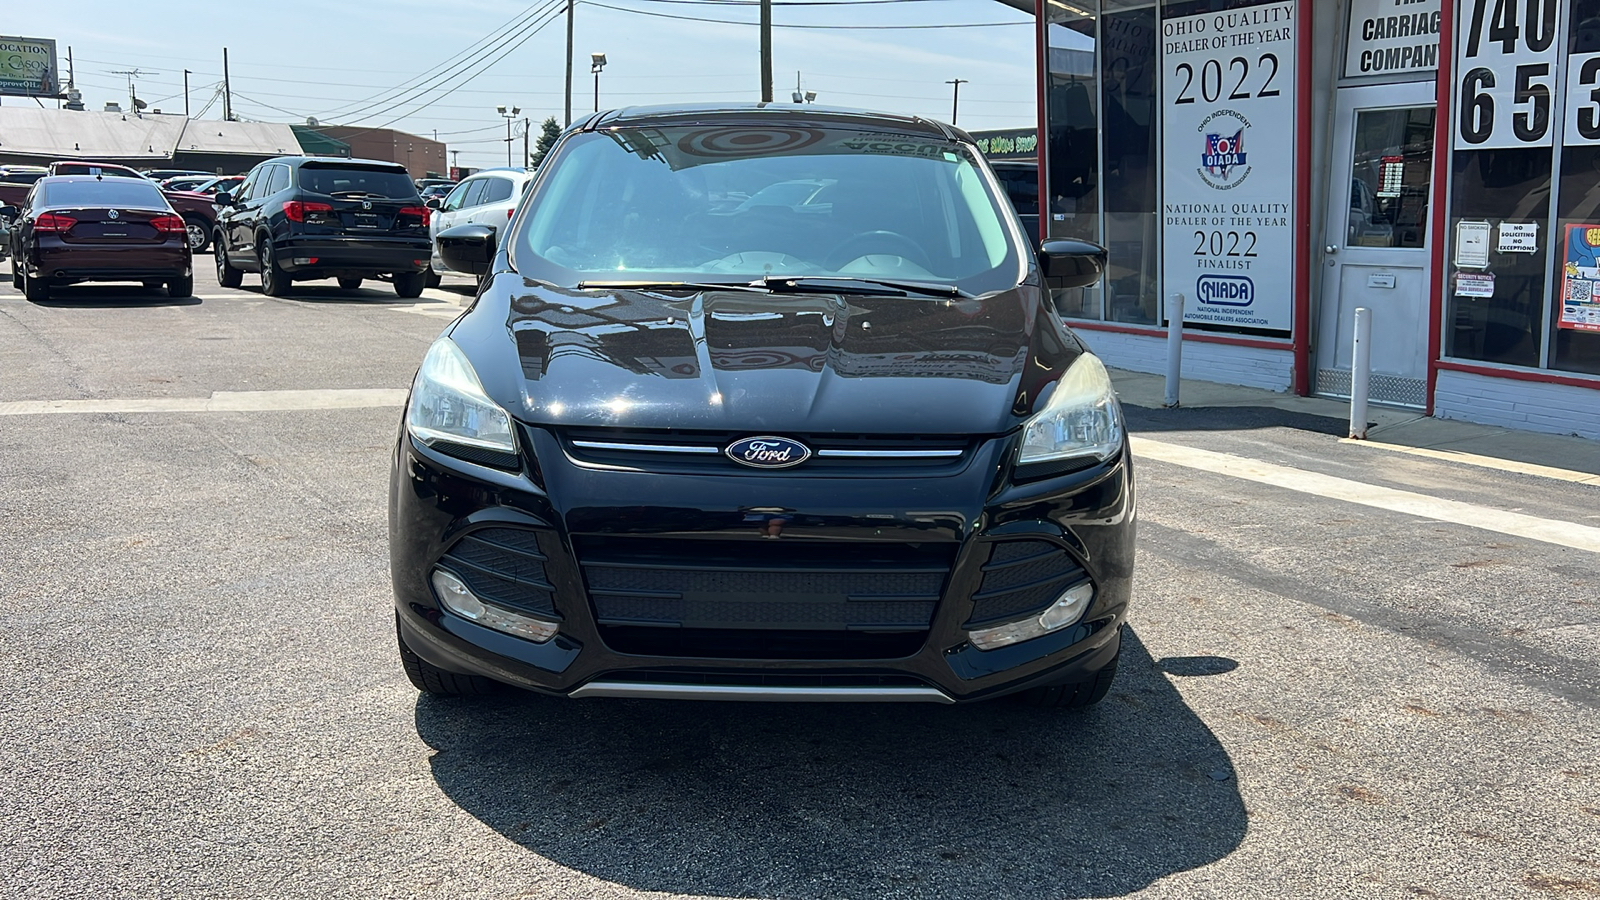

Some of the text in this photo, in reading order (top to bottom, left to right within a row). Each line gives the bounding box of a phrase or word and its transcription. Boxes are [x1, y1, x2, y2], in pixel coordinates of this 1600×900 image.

[1164, 5, 1293, 37] OHIO QUALITY
[1165, 38, 1209, 54] DEALER
[1211, 36, 1227, 49] OF
[1230, 32, 1254, 46] THE
[1257, 27, 1290, 43] YEAR
[8, 54, 48, 70] CASON
[1360, 43, 1440, 72] COMPAN
[1174, 52, 1280, 105] 2022
[1197, 109, 1252, 133] OHIO INDEPENDENT
[1015, 134, 1038, 153] SHOP
[1207, 154, 1239, 166] OIADA
[1165, 203, 1289, 215] NATIONAL QUALITY
[1166, 217, 1287, 227] DEALER OF THE YEAR
[1193, 230, 1258, 258] 2022
[1197, 259, 1252, 270] FINALIST
[1201, 281, 1249, 301] NIADA
[1184, 312, 1269, 325] AUTOMOBILE DEALERS ASSOCIATION
[1197, 306, 1254, 316] NATIONAL INDEPENDENT
[744, 440, 792, 461] Ford
